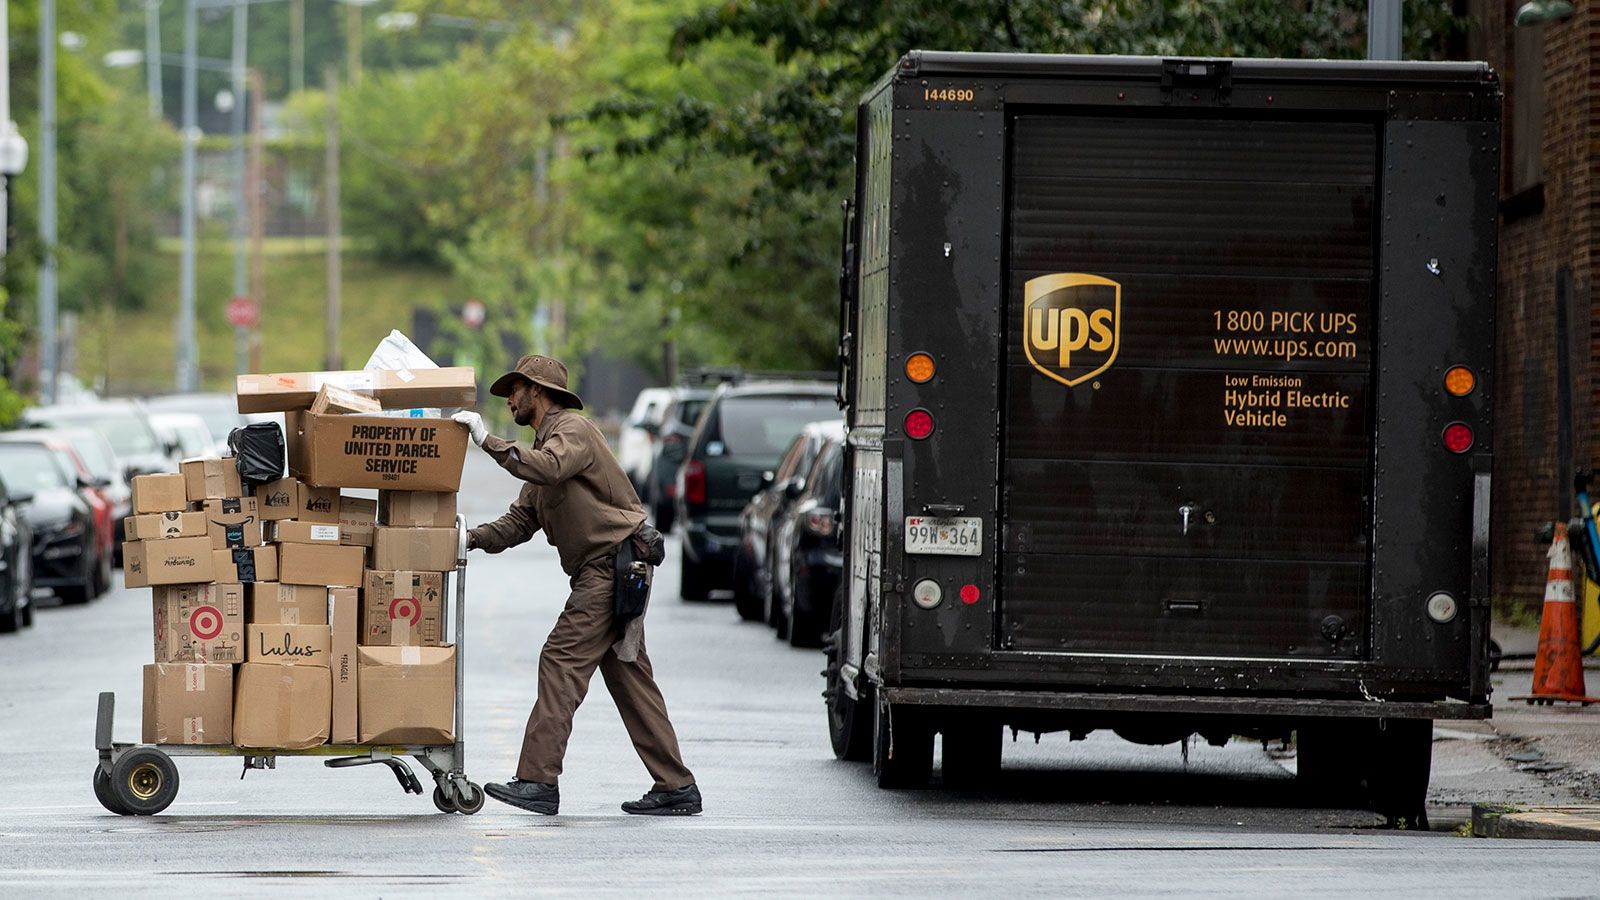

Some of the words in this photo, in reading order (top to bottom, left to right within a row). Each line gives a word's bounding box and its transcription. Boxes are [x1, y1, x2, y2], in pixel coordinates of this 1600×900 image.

[1214, 310, 1221, 331] 1
[1227, 310, 1264, 331] 800
[1271, 311, 1315, 333] PICK
[1320, 312, 1357, 334] UPS
[1032, 308, 1113, 368] ups
[1214, 339, 1356, 361] www.ups.com
[1225, 375, 1248, 387] Low
[1252, 375, 1302, 388] Emission
[1225, 390, 1280, 410] Hybrid
[1287, 391, 1349, 408] Electric
[1224, 409, 1287, 427] Vehicle
[352, 425, 416, 441] PROPERTY
[420, 427, 436, 441] OF
[344, 441, 391, 456] UNITED
[395, 443, 440, 458] PARCEL
[365, 458, 417, 473] SERVICE
[909, 526, 938, 544] 99W
[950, 527, 978, 545] 364
[260, 632, 321, 656] Lulus
